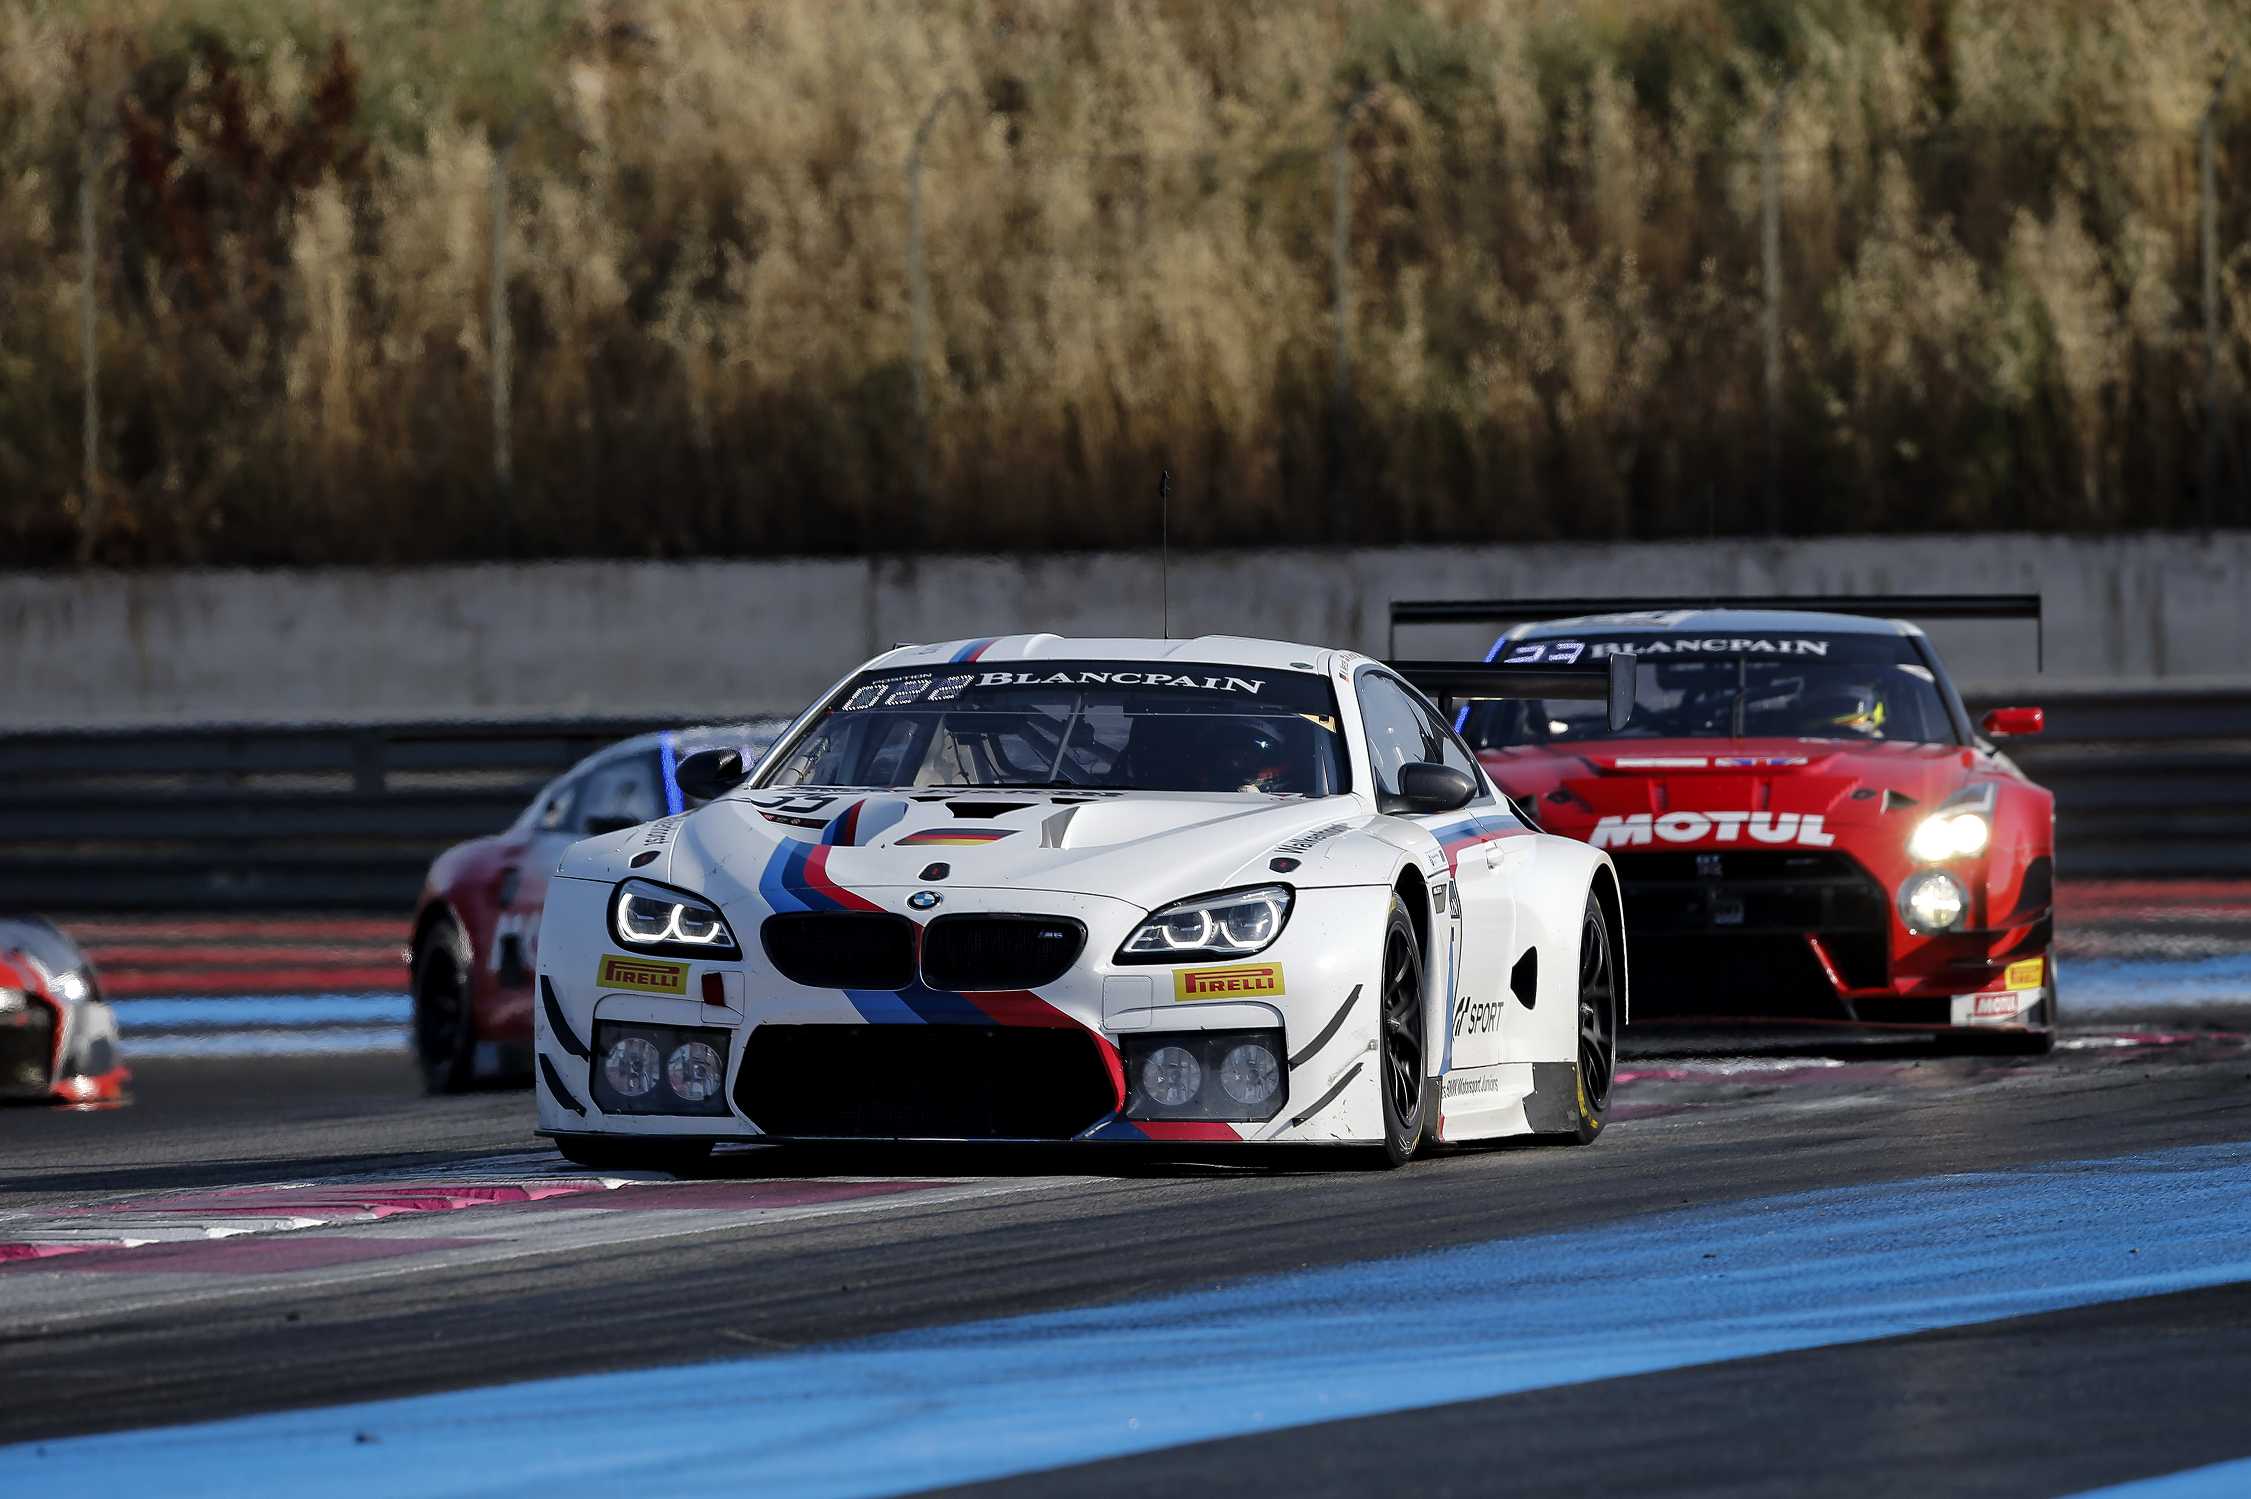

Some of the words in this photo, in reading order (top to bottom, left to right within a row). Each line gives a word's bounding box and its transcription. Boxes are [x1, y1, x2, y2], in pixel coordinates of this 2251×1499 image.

[1591, 639, 1830, 658] BLANCPAIN
[975, 671, 1266, 694] BLANCPAIN
[1590, 811, 1835, 848] MOTUL
[605, 959, 681, 988] PIRELLI
[1184, 968, 1274, 993] PIRELLI
[1468, 1001, 1504, 1034] SPORT
